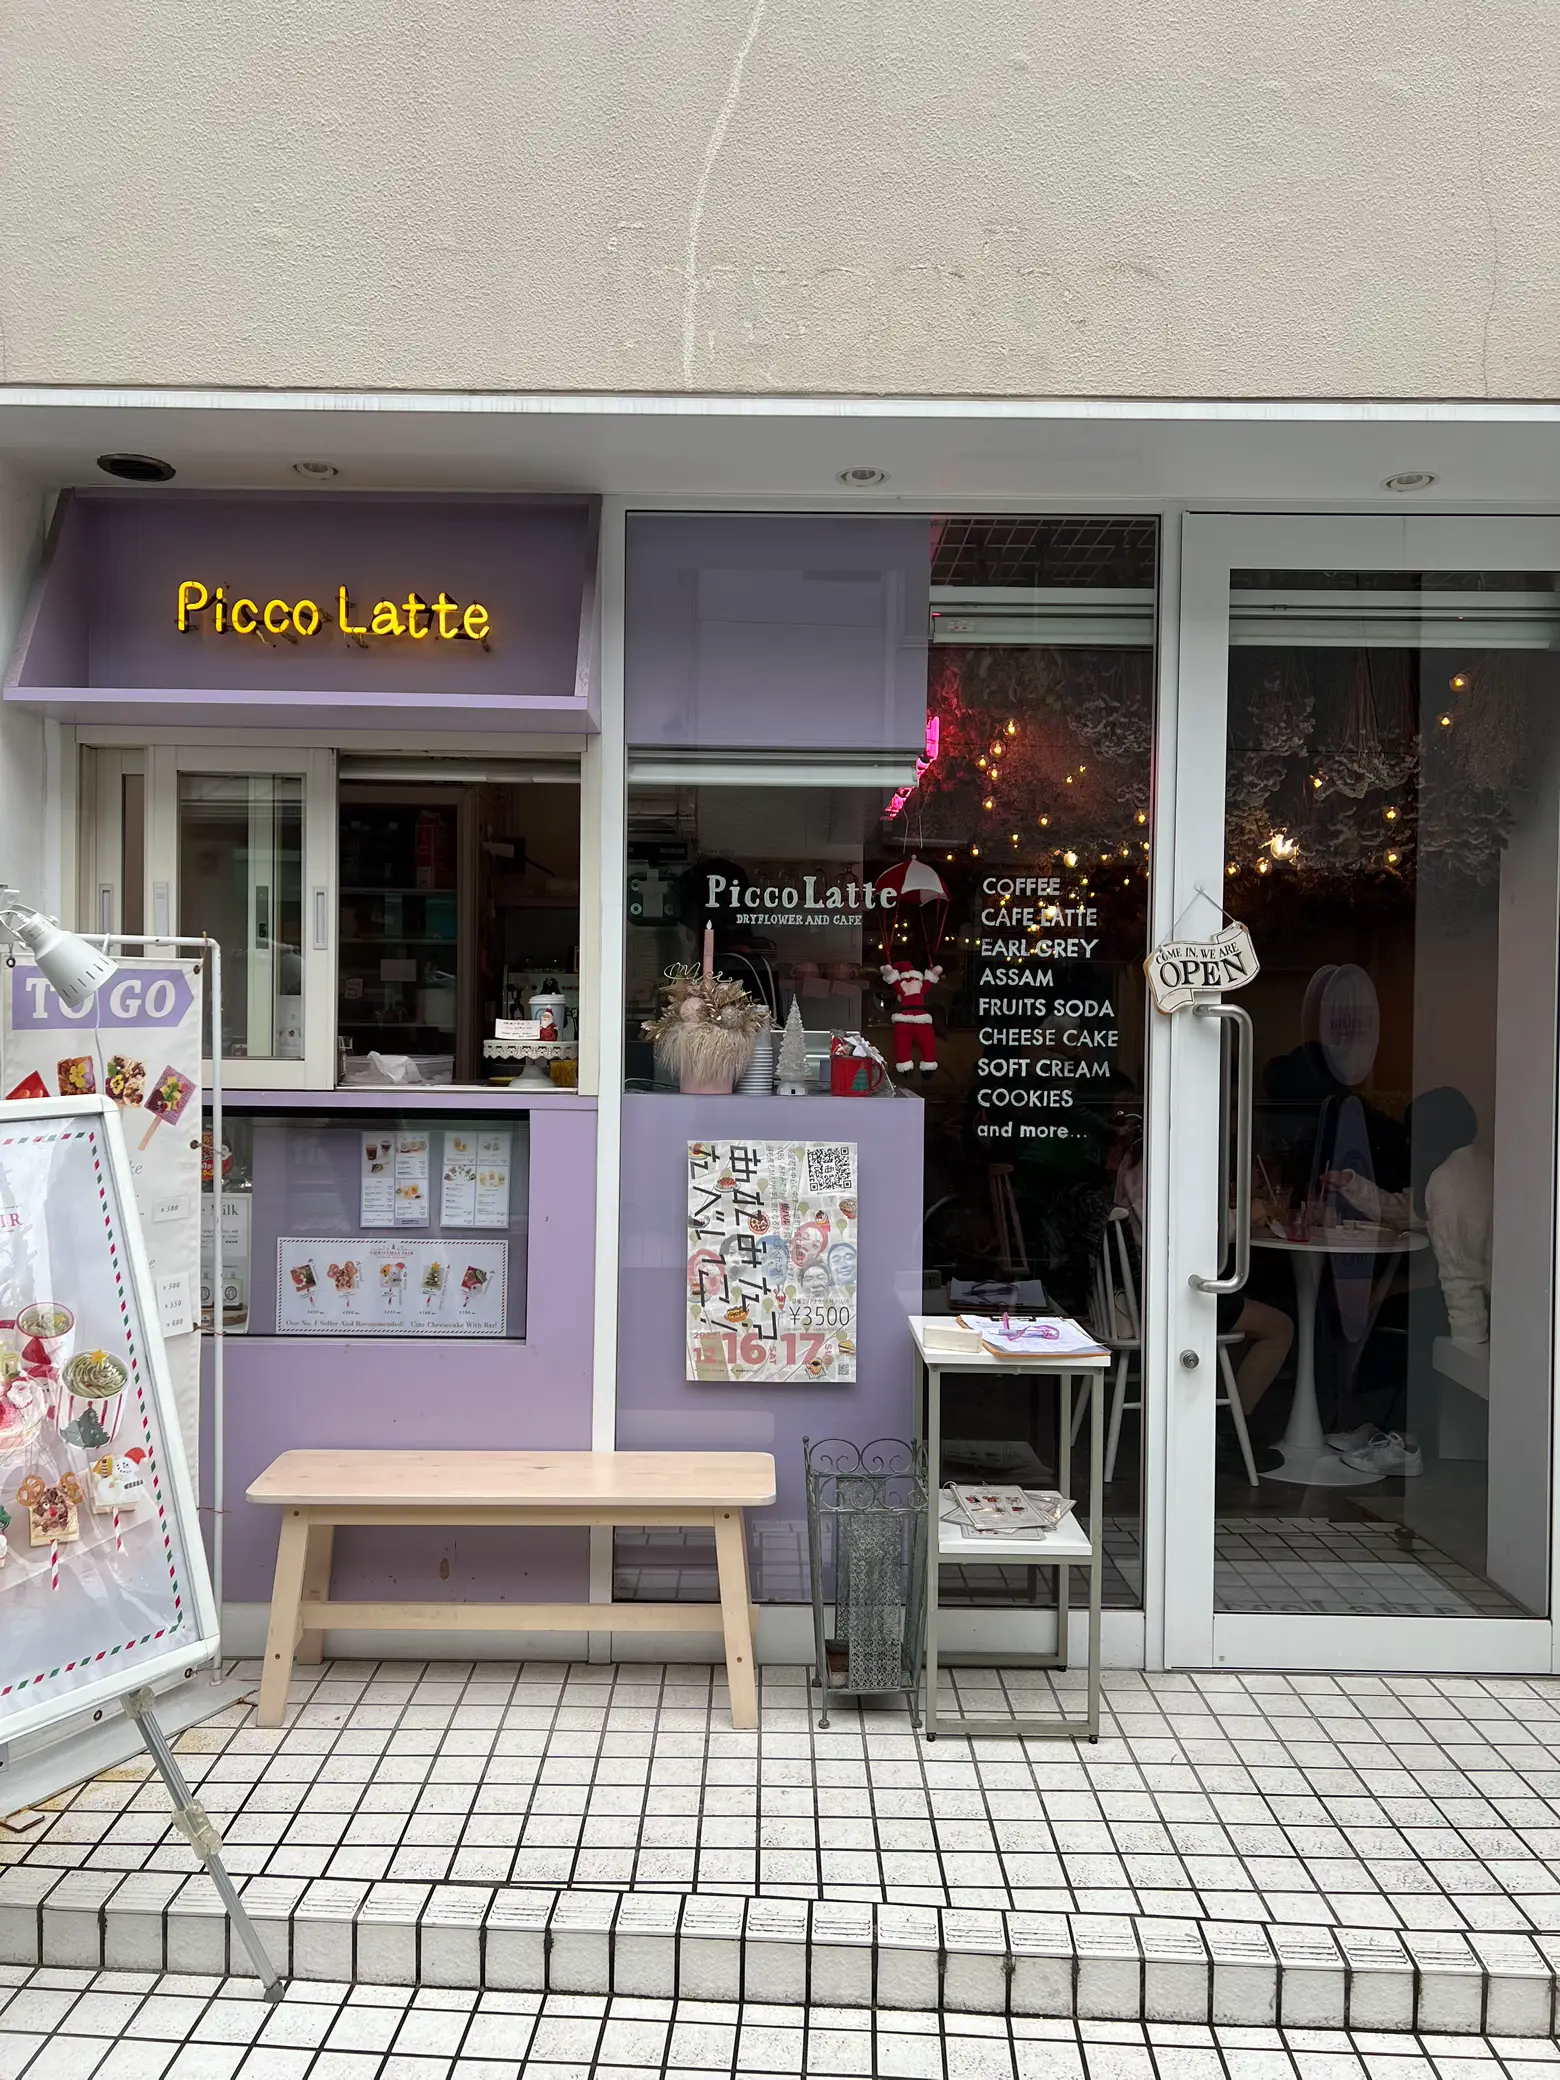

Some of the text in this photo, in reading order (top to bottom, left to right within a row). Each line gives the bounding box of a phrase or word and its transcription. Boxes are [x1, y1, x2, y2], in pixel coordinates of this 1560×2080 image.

[177, 579, 490, 640] Picco Latte
[982, 877, 1061, 896] COFFEE
[736, 913, 862, 926] DRYFLOWER AND CAFE
[981, 907, 1098, 927] CAFE LATTE
[981, 938, 1099, 959] EARL GREY
[1155, 948, 1183, 965] COME
[1201, 949, 1216, 960] WE
[1219, 941, 1240, 958] ARE
[979, 967, 1054, 987] ASSAM
[1159, 951, 1249, 988] OPEN
[25, 977, 177, 1020] TO GO
[978, 997, 1116, 1018] FRUITS SODA
[978, 1027, 1119, 1048] CHEESE CAKE
[977, 1058, 1111, 1079] SOFT CREAM
[977, 1088, 1074, 1108] COOKIES
[977, 1121, 1088, 1139] and more...
[788, 1305, 850, 1326] ¥3500
[721, 1332, 767, 1366] 16
[768, 1345, 777, 1365] SAT
[779, 1332, 826, 1366] 17
